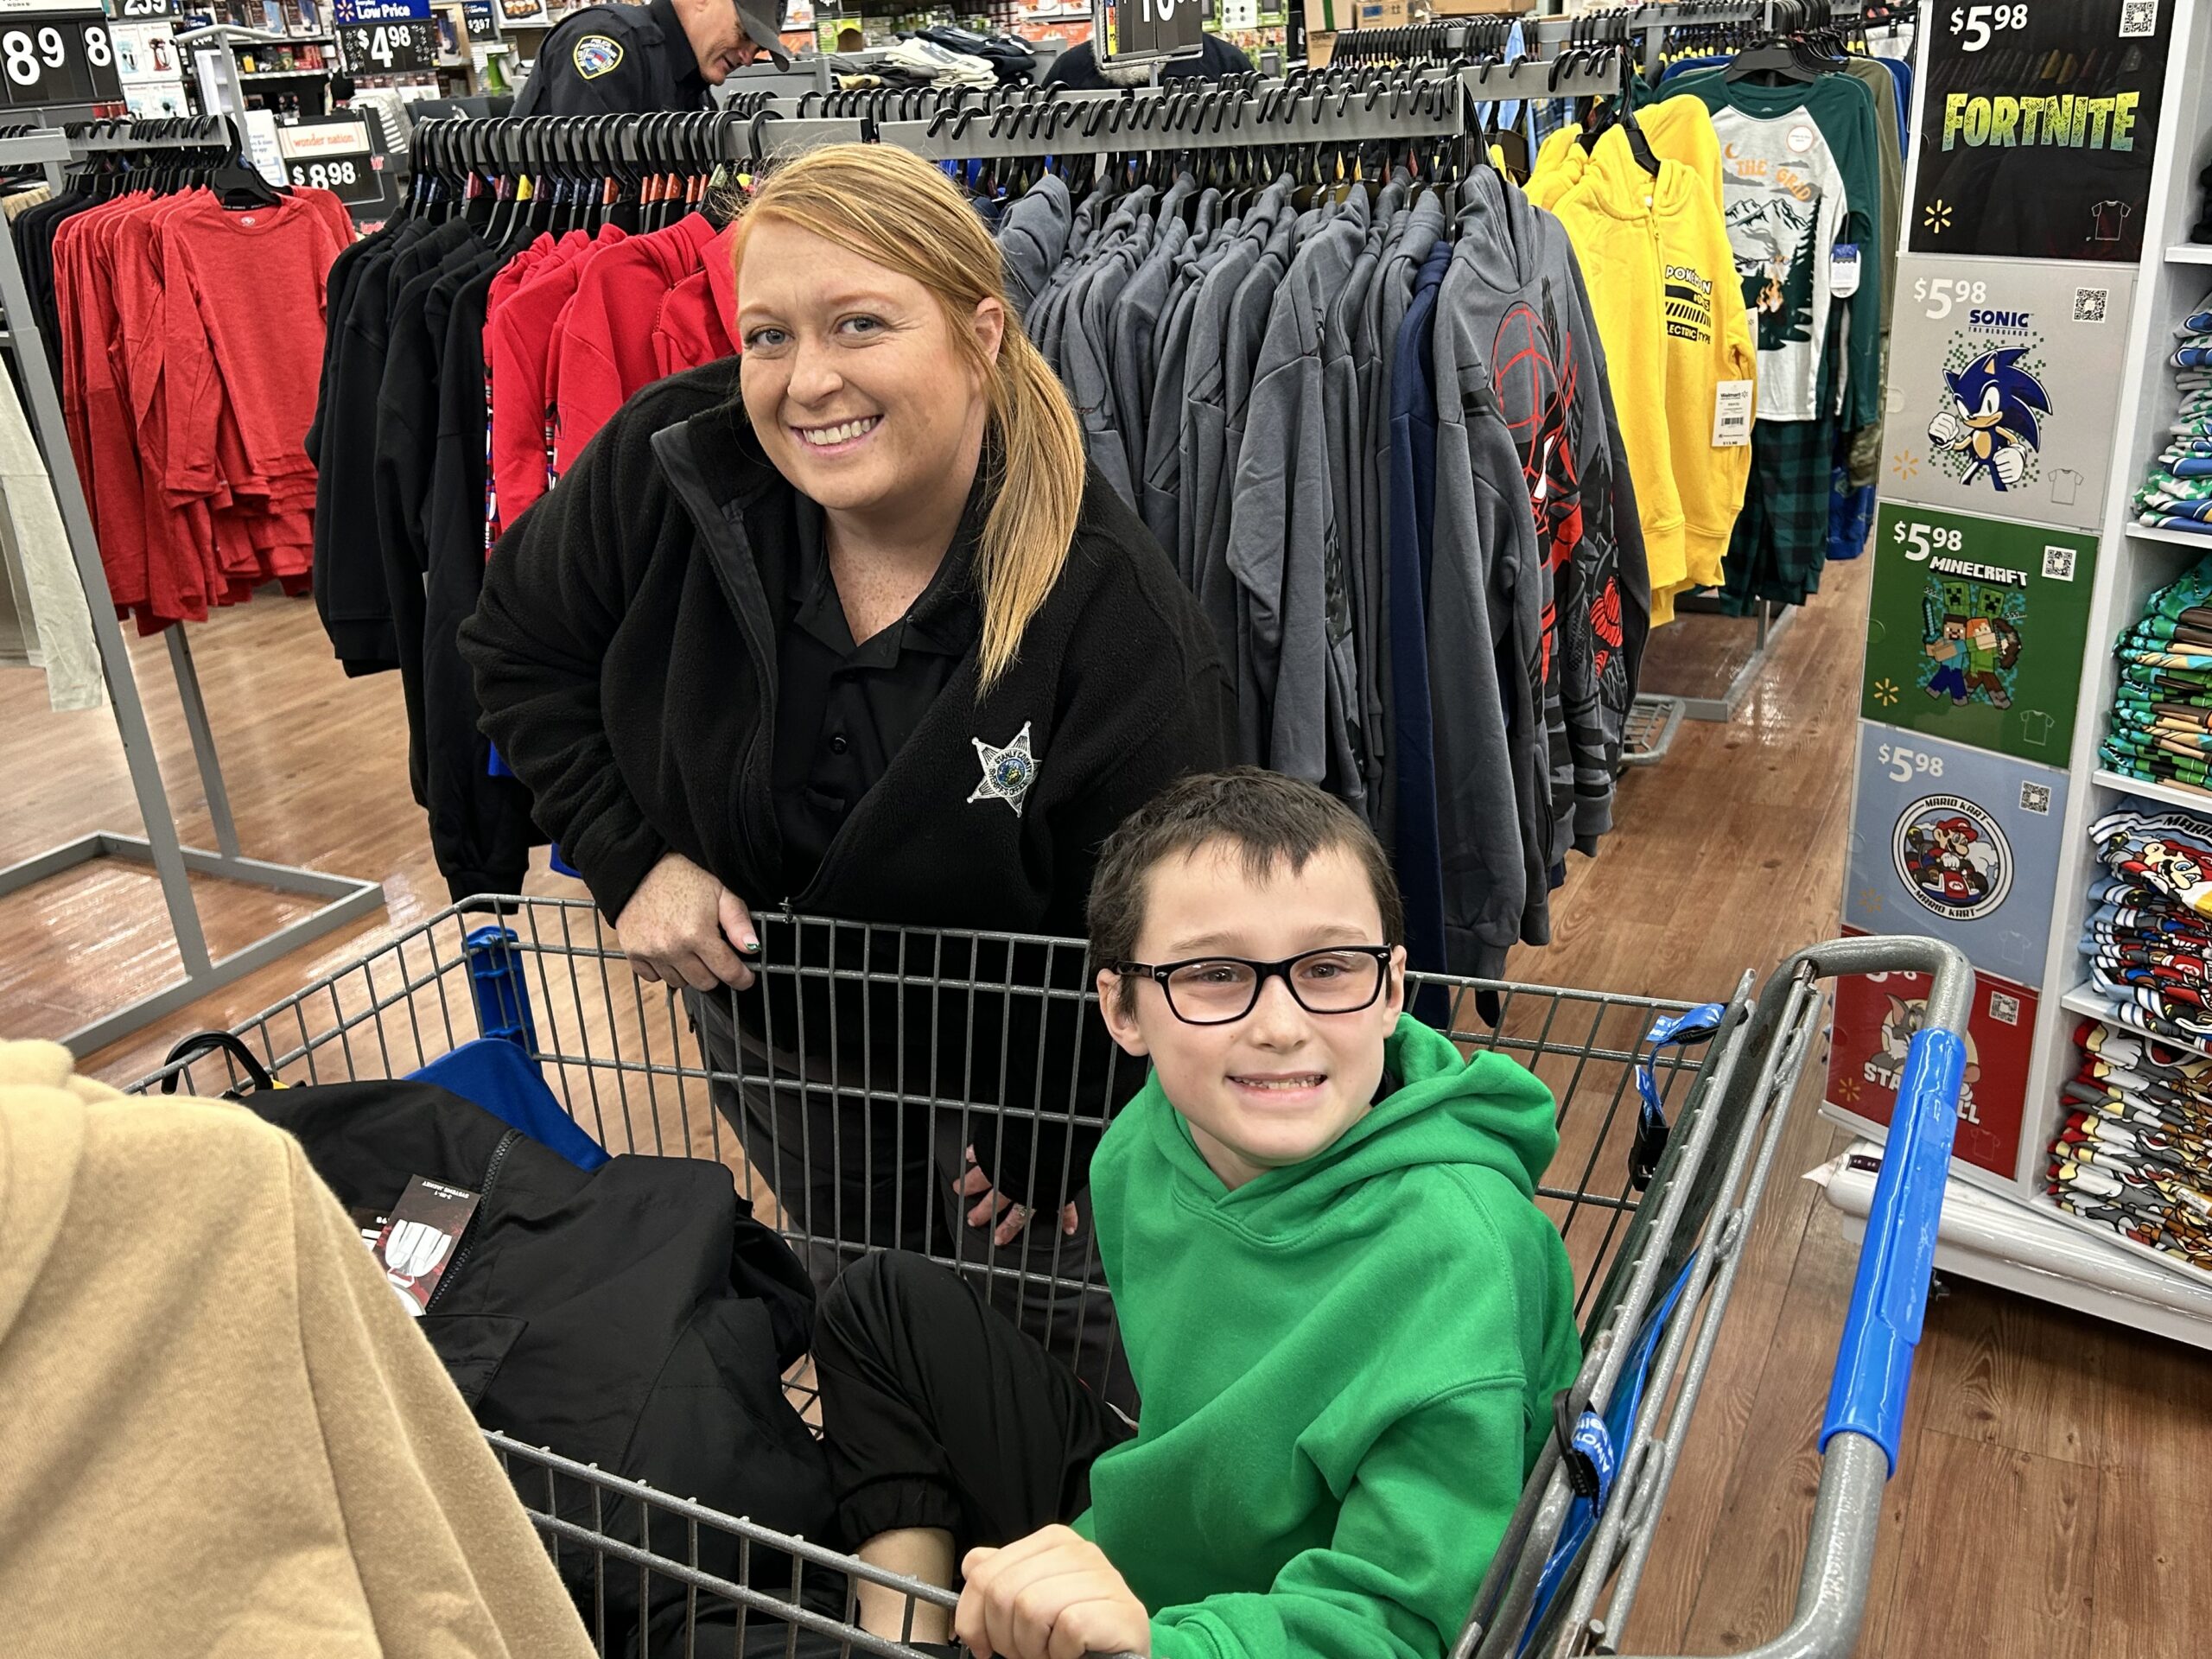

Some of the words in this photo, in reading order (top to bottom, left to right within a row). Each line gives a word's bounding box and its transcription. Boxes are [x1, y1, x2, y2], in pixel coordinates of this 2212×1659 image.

[356, 6, 380, 19] Low
[381, 3, 410, 17] Price
[1942, 91, 2140, 152] FORTNITE
[294, 133, 324, 147] wonder
[327, 134, 354, 145] nation
[1969, 309, 2030, 327] SONIC
[1929, 556, 2028, 588] MINECRAFT
[1924, 798, 1958, 808] MARIO
[1960, 803, 1987, 822] KART
[1915, 889, 1945, 913] MARIO
[1948, 908, 1976, 918] KART
[1577, 1432, 1610, 1473] Alway
